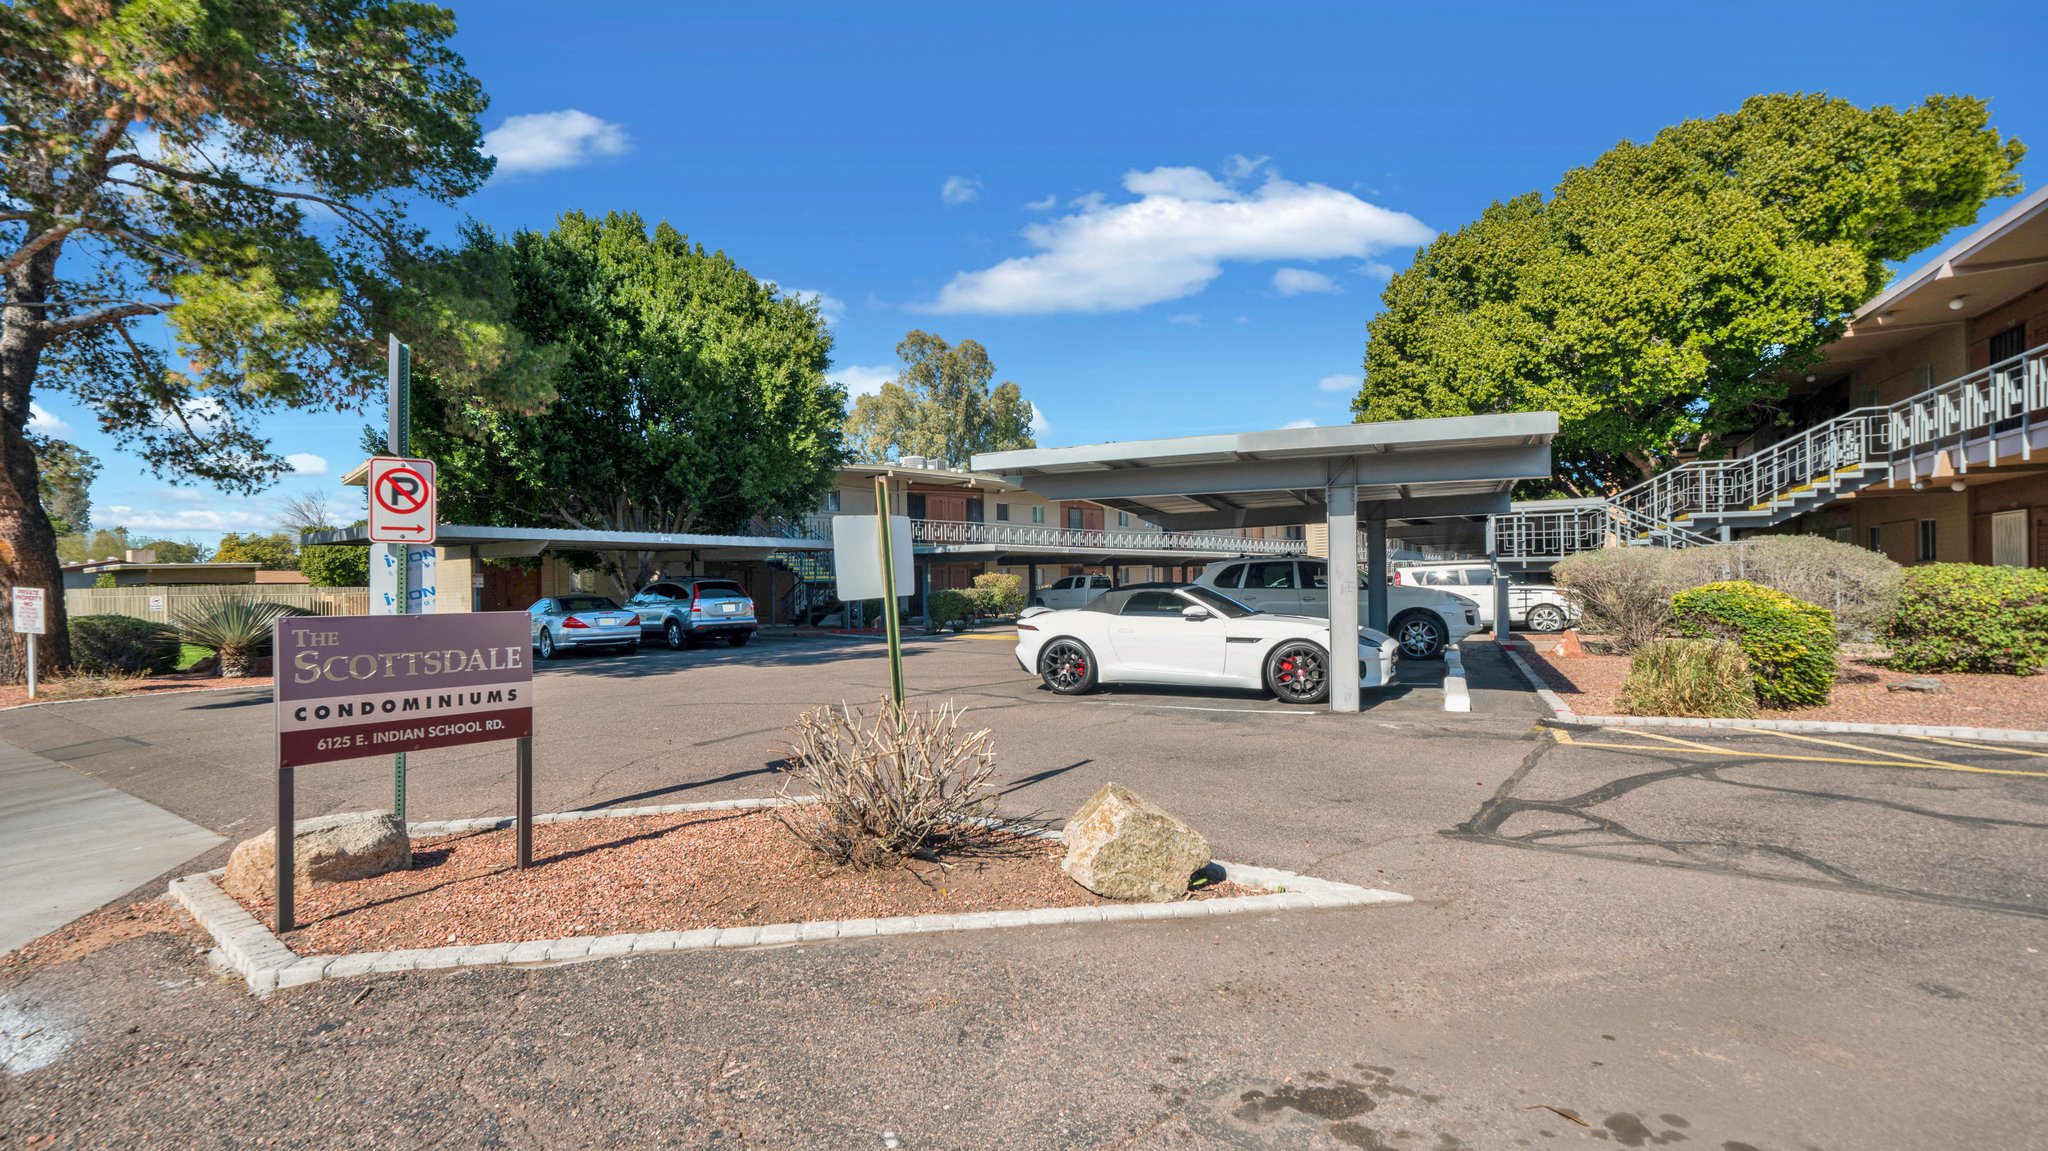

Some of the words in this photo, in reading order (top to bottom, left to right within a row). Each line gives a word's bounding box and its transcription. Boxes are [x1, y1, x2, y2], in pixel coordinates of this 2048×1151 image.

[291, 629, 339, 647] THE
[294, 646, 522, 684] SCOTTSDALE
[294, 689, 517, 722] CONDOMINIUMS
[317, 735, 351, 750] 6125
[355, 734, 368, 746] E.
[373, 727, 425, 744] INDIAN
[428, 721, 482, 737] SCHOOL
[486, 719, 505, 730] RD.
